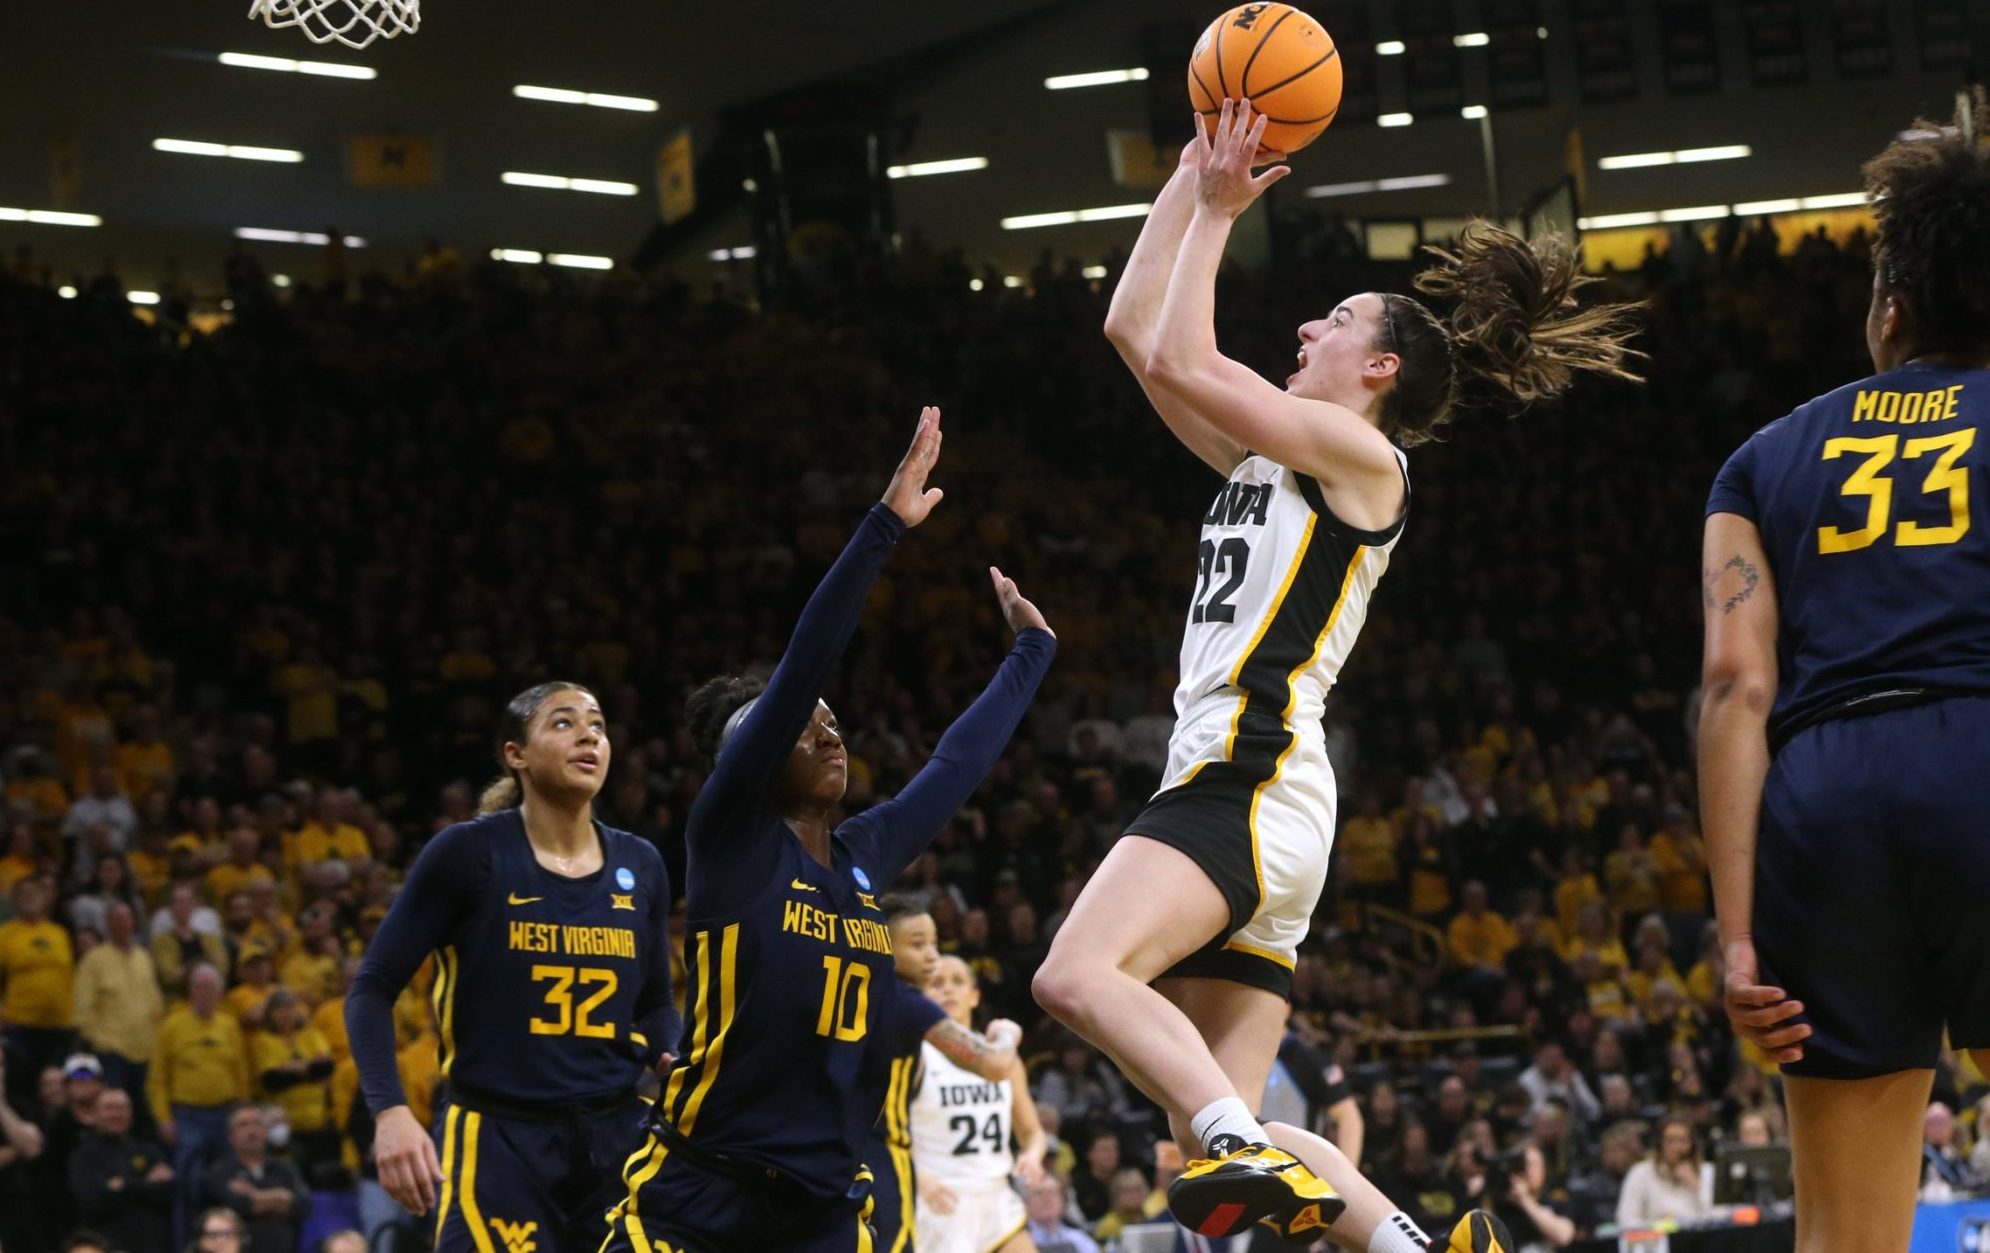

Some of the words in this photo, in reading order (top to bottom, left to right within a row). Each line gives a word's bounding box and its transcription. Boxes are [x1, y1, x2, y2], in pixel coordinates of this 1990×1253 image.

[1852, 385, 1965, 424] MOORE
[1817, 427, 1978, 555] 33
[1192, 537, 1251, 625] 22
[509, 921, 560, 953] WEST
[562, 925, 636, 959] VIRGINIA
[782, 900, 839, 943] WEST
[529, 964, 618, 1039] 32
[816, 955, 871, 1042] 10
[939, 1083, 1004, 1107] IOWA
[949, 1112, 1003, 1156] 24
